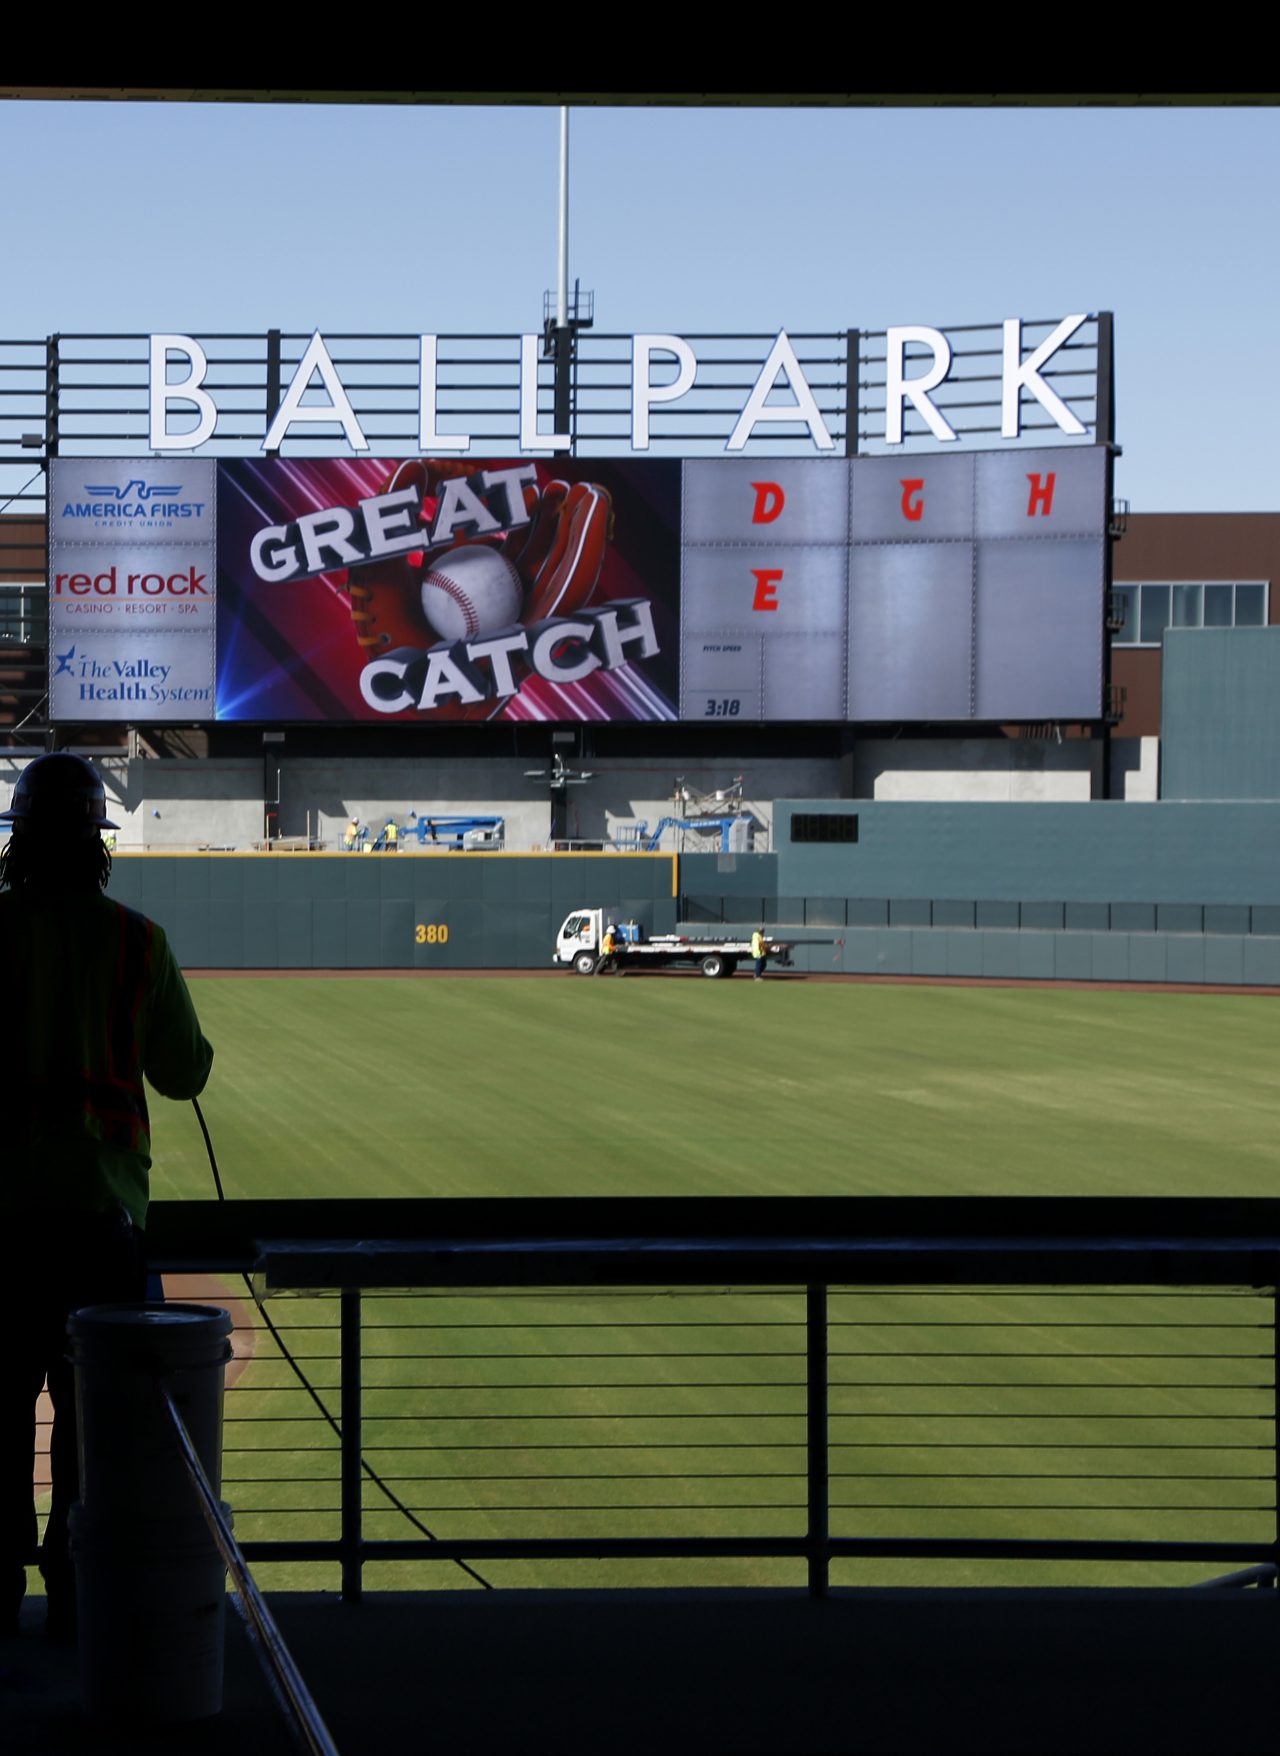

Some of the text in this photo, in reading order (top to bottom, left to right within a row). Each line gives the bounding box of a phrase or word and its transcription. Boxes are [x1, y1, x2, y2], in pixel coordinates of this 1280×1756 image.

[148, 312, 1098, 452] BALLPARK
[749, 481, 785, 524] D
[1026, 472, 1056, 516] H
[62, 503, 205, 517] AMERICA FIRST
[250, 463, 538, 583] GREAT
[55, 566, 209, 595] red rock
[750, 569, 784, 611] E
[65, 603, 198, 614] CASINO RESORT SPA
[79, 659, 171, 683] The Valley
[359, 599, 661, 714] CATCH
[80, 682, 210, 705] Health System
[705, 699, 741, 716] 3:18
[415, 924, 449, 944] 380
